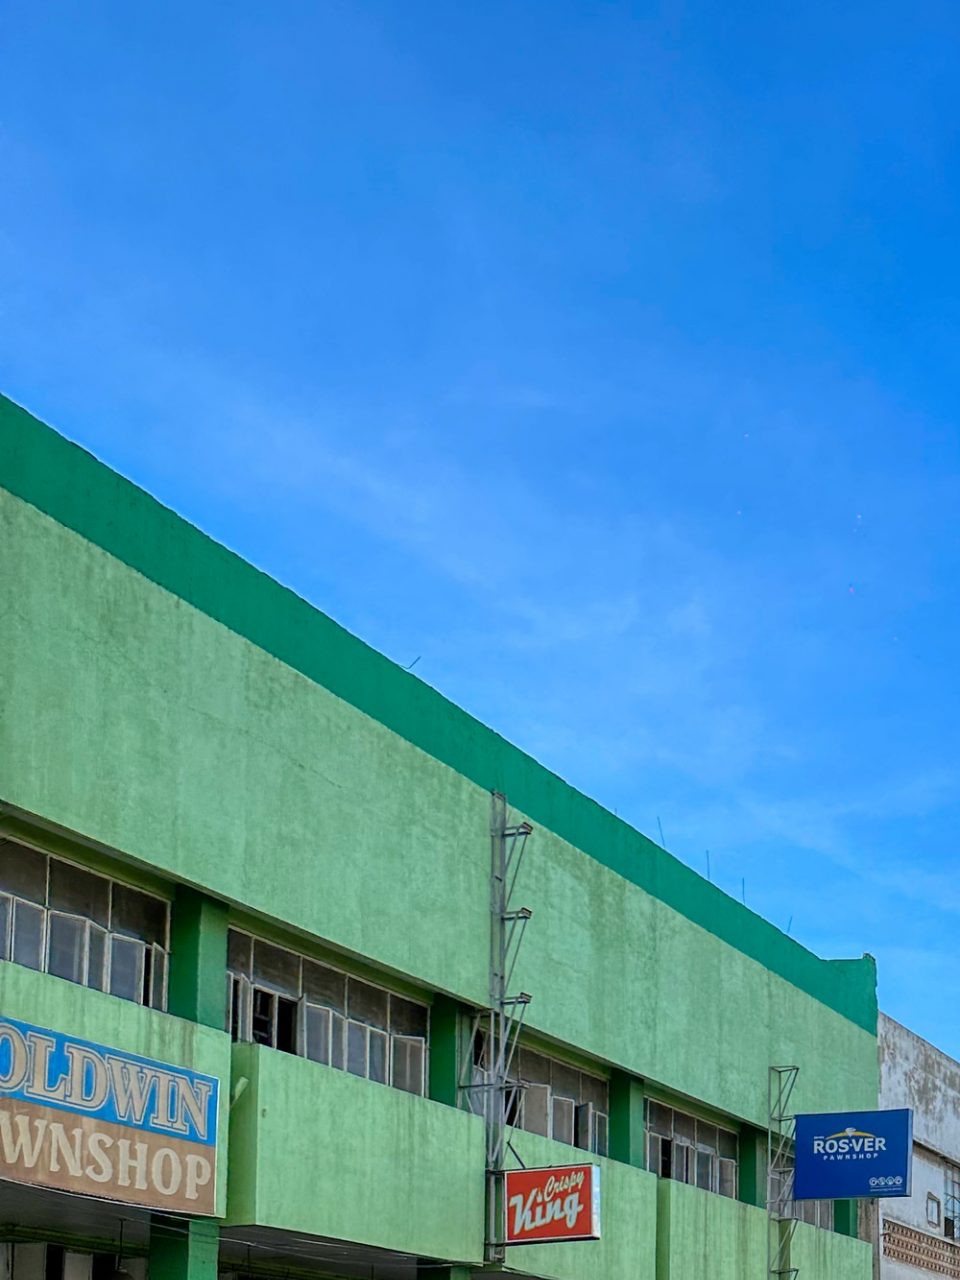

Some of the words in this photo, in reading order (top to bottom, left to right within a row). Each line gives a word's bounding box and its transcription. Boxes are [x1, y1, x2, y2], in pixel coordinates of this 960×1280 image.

[823, 1152, 878, 1161] PAWNSHOP
[544, 1171, 585, 1202] Crispy
[509, 1188, 584, 1236] King
